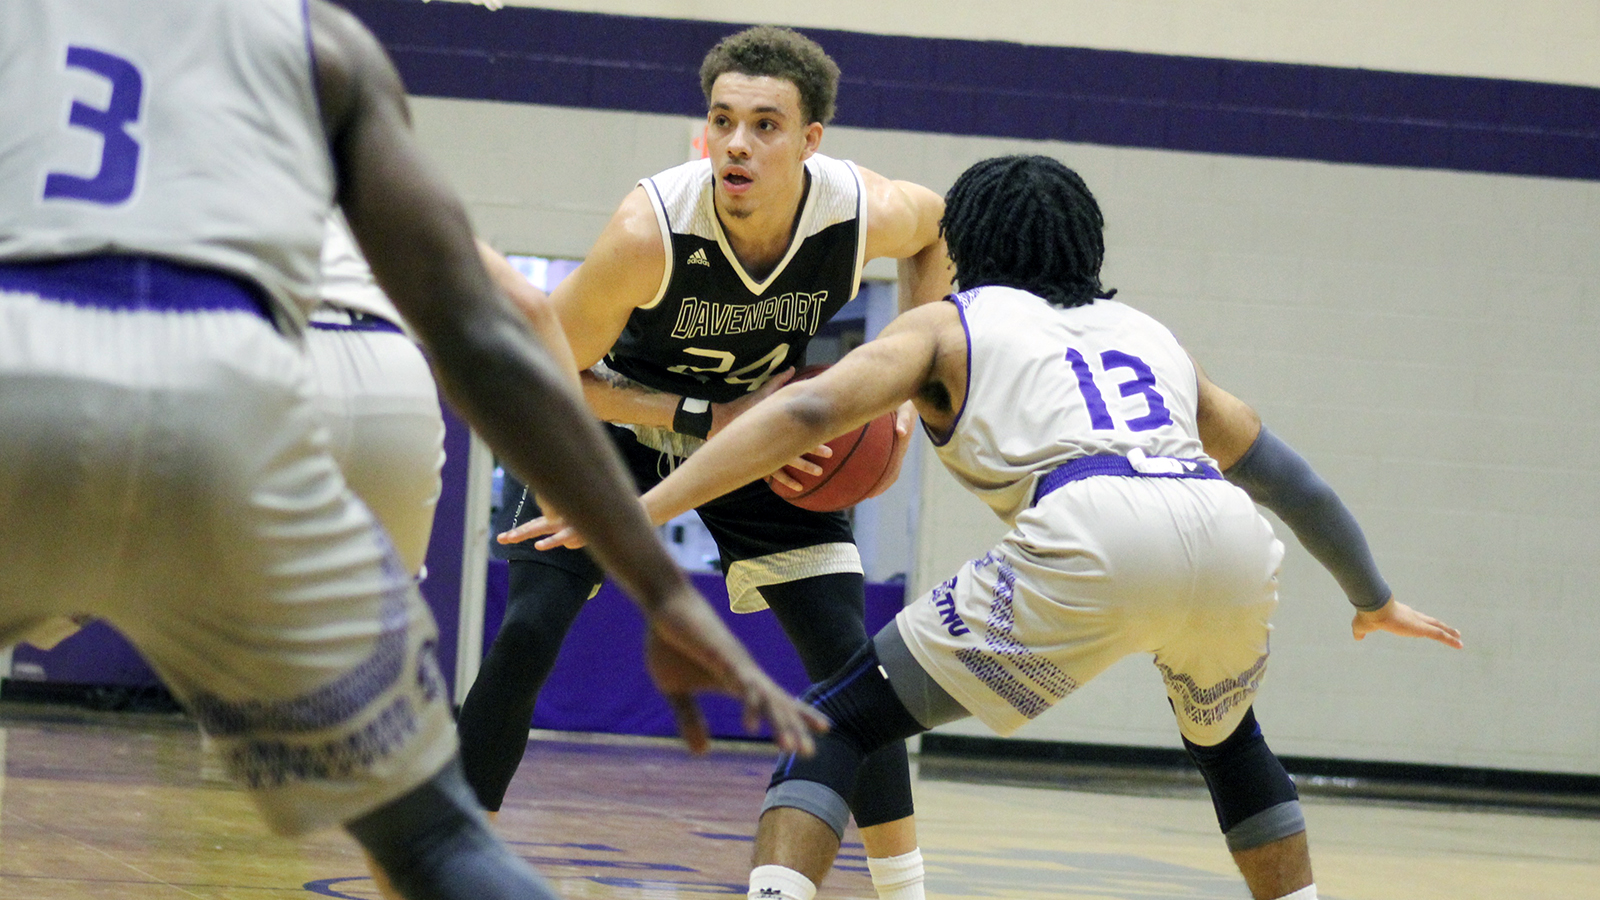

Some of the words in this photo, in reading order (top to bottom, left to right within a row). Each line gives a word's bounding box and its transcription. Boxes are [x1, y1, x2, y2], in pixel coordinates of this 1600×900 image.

[43, 45, 142, 206] 3
[687, 258, 710, 267] adidas
[671, 291, 828, 339] DAVENPORT
[666, 343, 790, 391] 24
[1065, 347, 1173, 432] 13
[936, 592, 971, 637] TNU
